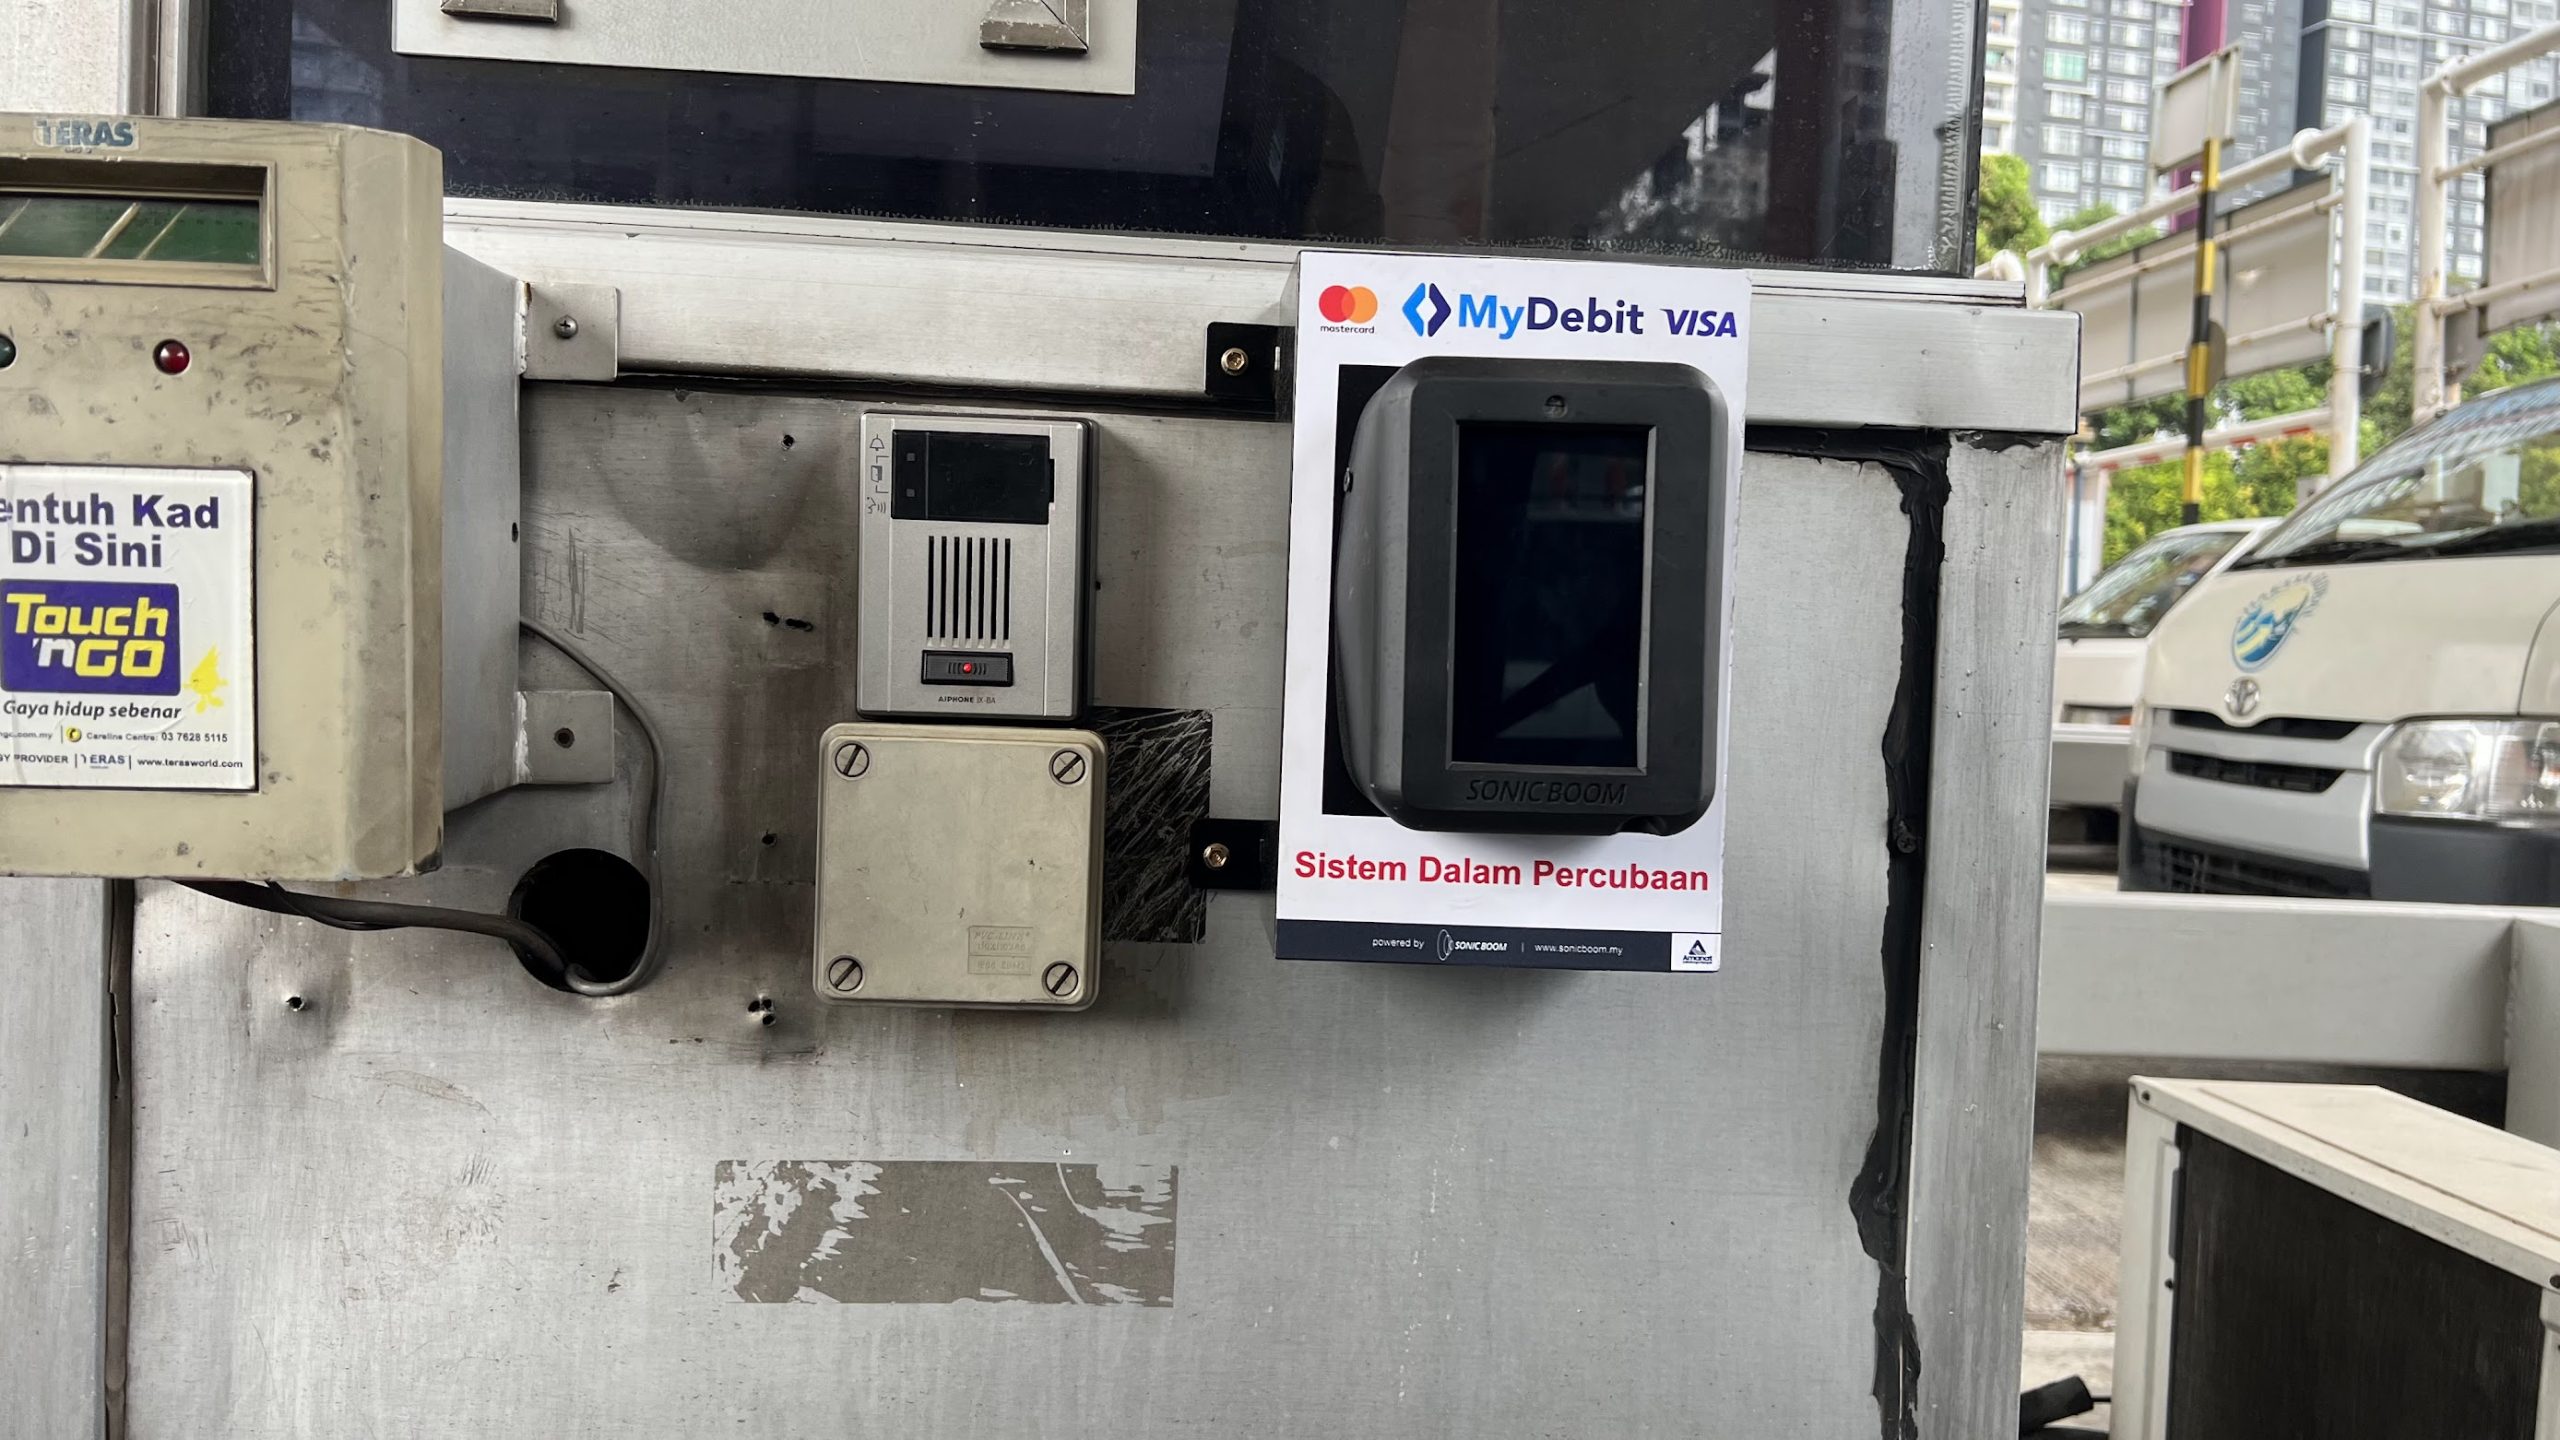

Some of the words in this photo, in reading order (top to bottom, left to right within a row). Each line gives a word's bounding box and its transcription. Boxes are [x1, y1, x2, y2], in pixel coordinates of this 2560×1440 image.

[36, 119, 133, 146] TERAS
[1320, 325, 1375, 335] mastercard
[1458, 294, 1644, 340] MyDebit
[1660, 308, 1738, 338] VISA
[132, 494, 219, 529] Kad
[12, 530, 56, 565] Di
[74, 532, 162, 568] Sini
[6, 593, 169, 637] Touch
[3, 700, 49, 719] Gaya
[53, 701, 104, 720] hidup
[109, 703, 182, 719] sebenar
[161, 732, 174, 741] 03
[176, 732, 201, 742] 7628
[204, 733, 228, 742] 5115
[137, 758, 243, 768] www.terasworld.com
[1466, 779, 1545, 802] SONIC
[1547, 781, 1630, 806] BOOM
[1294, 851, 1407, 881] Sistem
[1419, 856, 1521, 886] Dalam
[1533, 860, 1709, 892] Percubaan
[1372, 939, 1411, 948] powered
[1413, 938, 1425, 950] by
[1454, 941, 1481, 951] SONIC
[1481, 942, 1508, 951] BOOM
[1534, 943, 1624, 957] www.sonicboom.my
